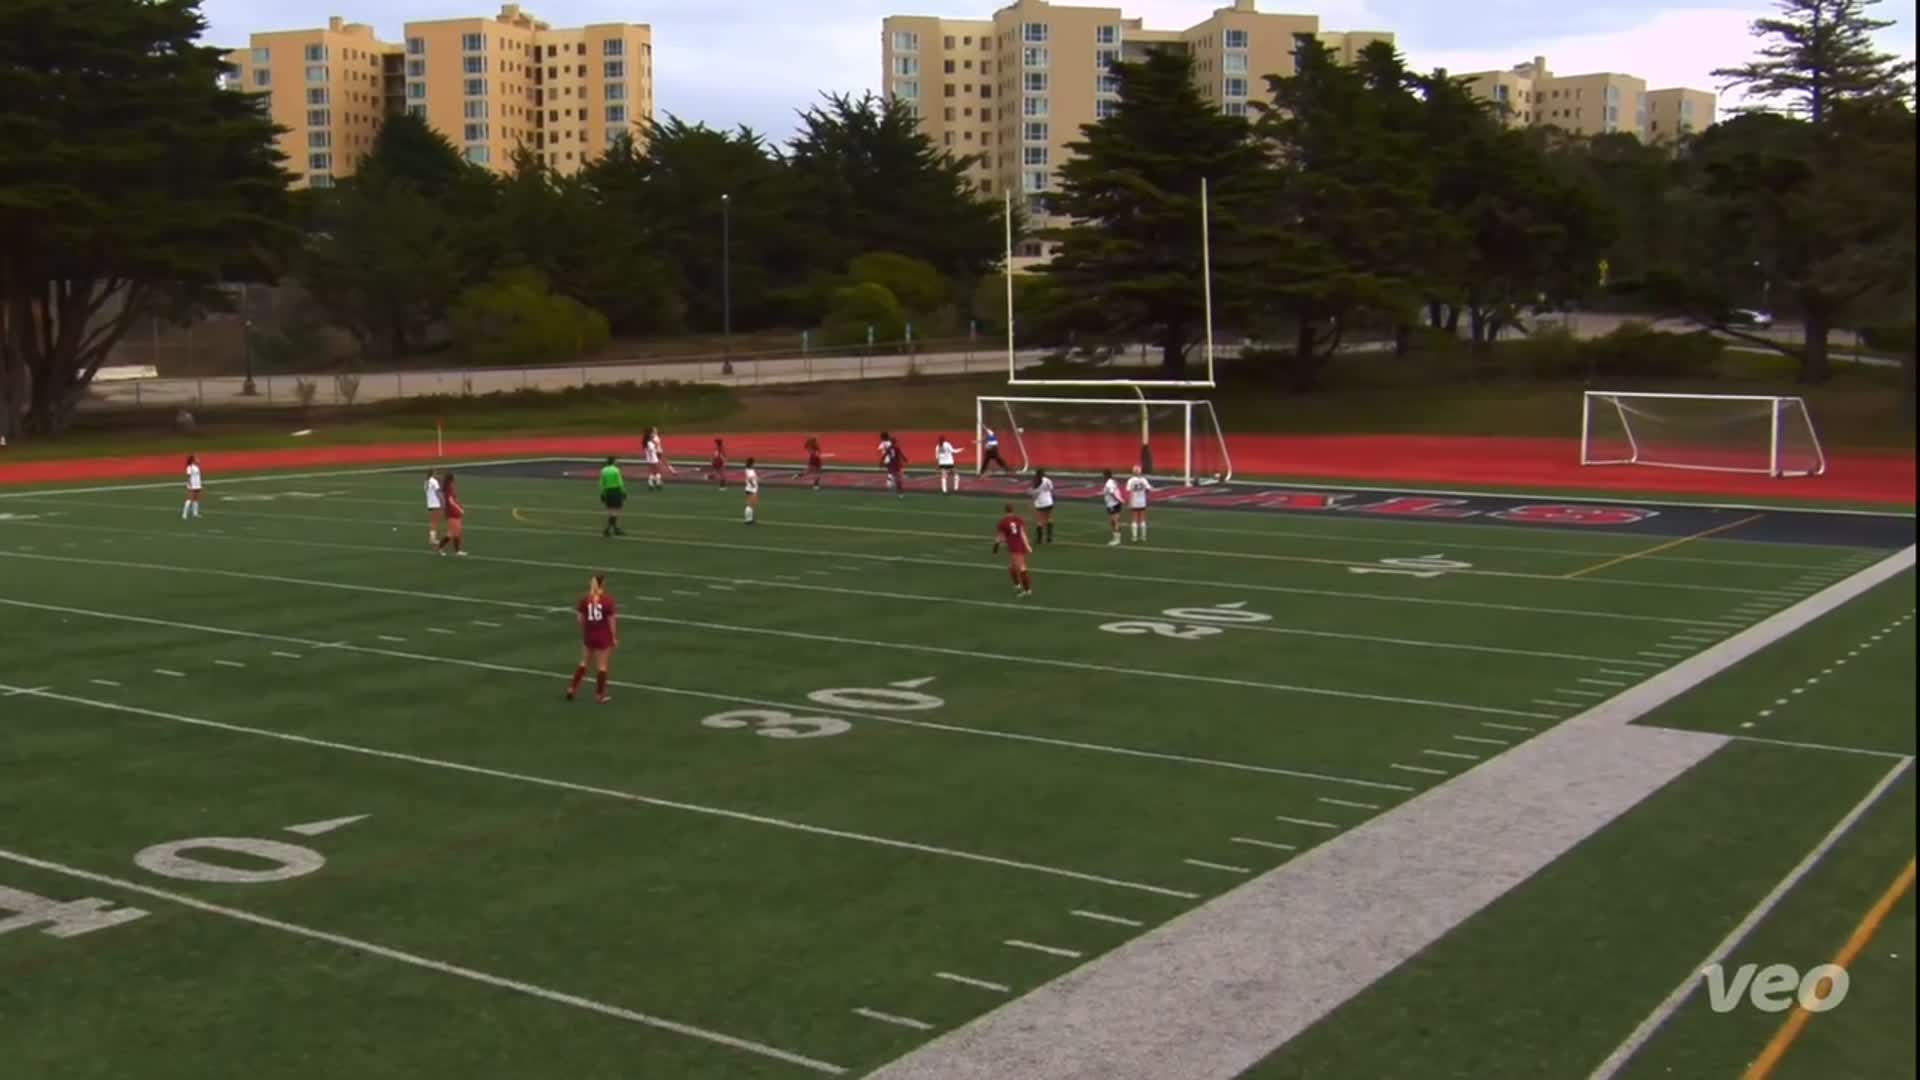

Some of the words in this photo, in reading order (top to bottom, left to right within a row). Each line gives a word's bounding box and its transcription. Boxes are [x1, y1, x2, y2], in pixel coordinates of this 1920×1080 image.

[1347, 557, 1473, 579] 10
[588, 603, 603, 621] 16
[1098, 606, 1272, 640] 20
[701, 687, 945, 740] 30
